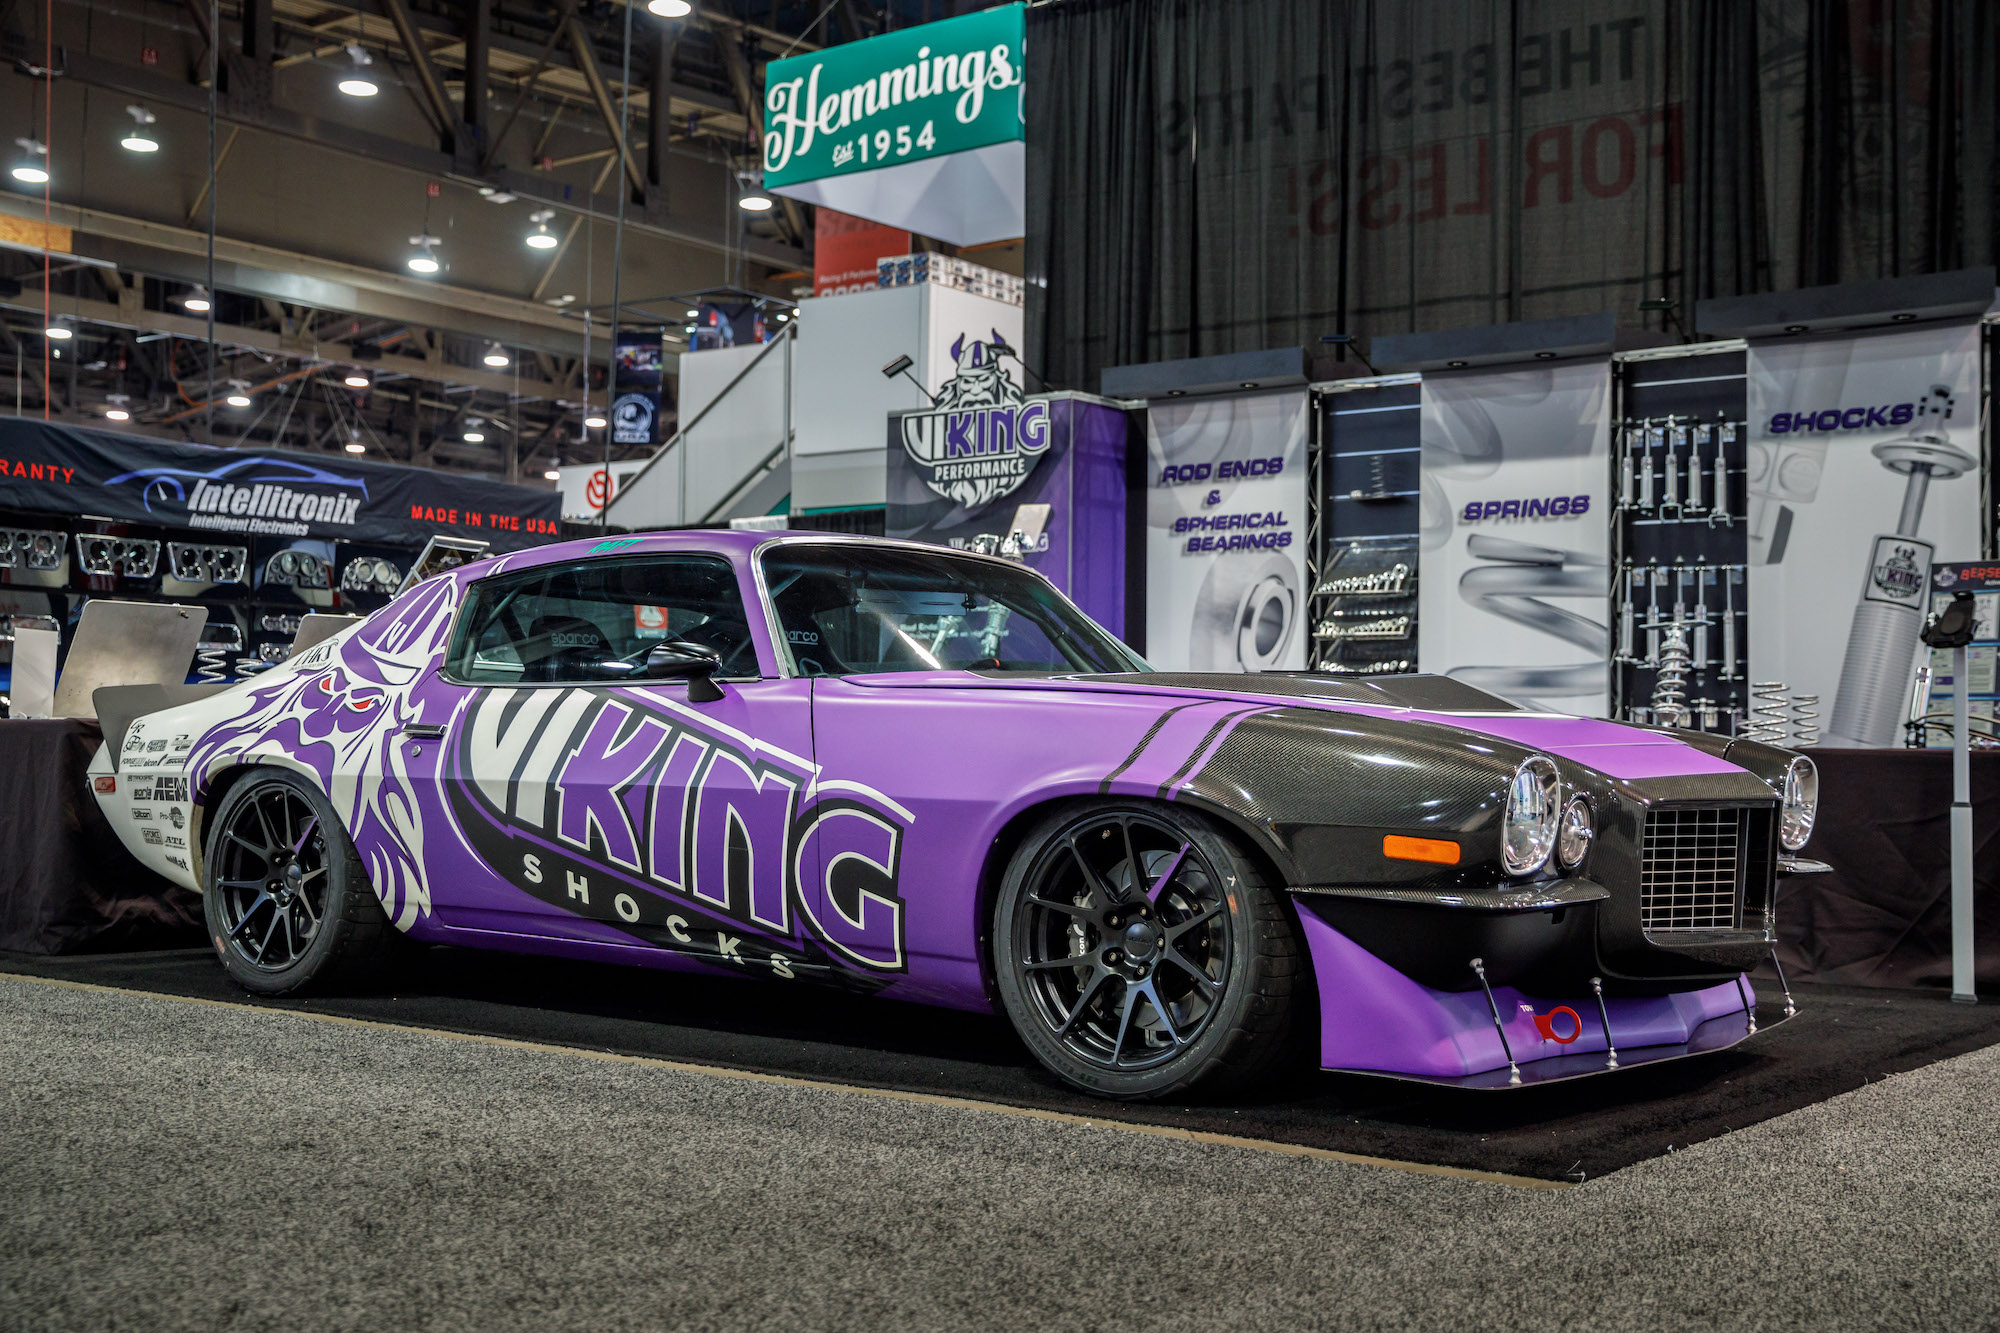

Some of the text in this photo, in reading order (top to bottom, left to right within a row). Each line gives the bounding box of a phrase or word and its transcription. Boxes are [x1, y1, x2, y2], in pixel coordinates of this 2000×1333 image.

[764, 43, 1021, 172] Hemmings
[832, 120, 937, 168] Est 1954
[1770, 403, 1915, 434] SHOCKS
[902, 399, 1051, 467] VIKING
[935, 458, 1026, 482] PERFORMANCE
[1162, 456, 1284, 483] ROD ENDS
[187, 478, 361, 525] Intellitronix
[1206, 489, 1221, 506] &
[1464, 494, 1591, 521] SPRINGS
[188, 512, 310, 537] Intelligent Electronics
[411, 504, 558, 535] MADE IN THE USA
[1174, 511, 1288, 533] SPHERICAL
[1187, 531, 1292, 552] BEARINGS
[551, 632, 600, 646] sparco
[784, 630, 819, 643] arco
[164, 836, 186, 846] ATL
[469, 686, 906, 970] VIKING
[523, 852, 796, 980] SHOCKS
